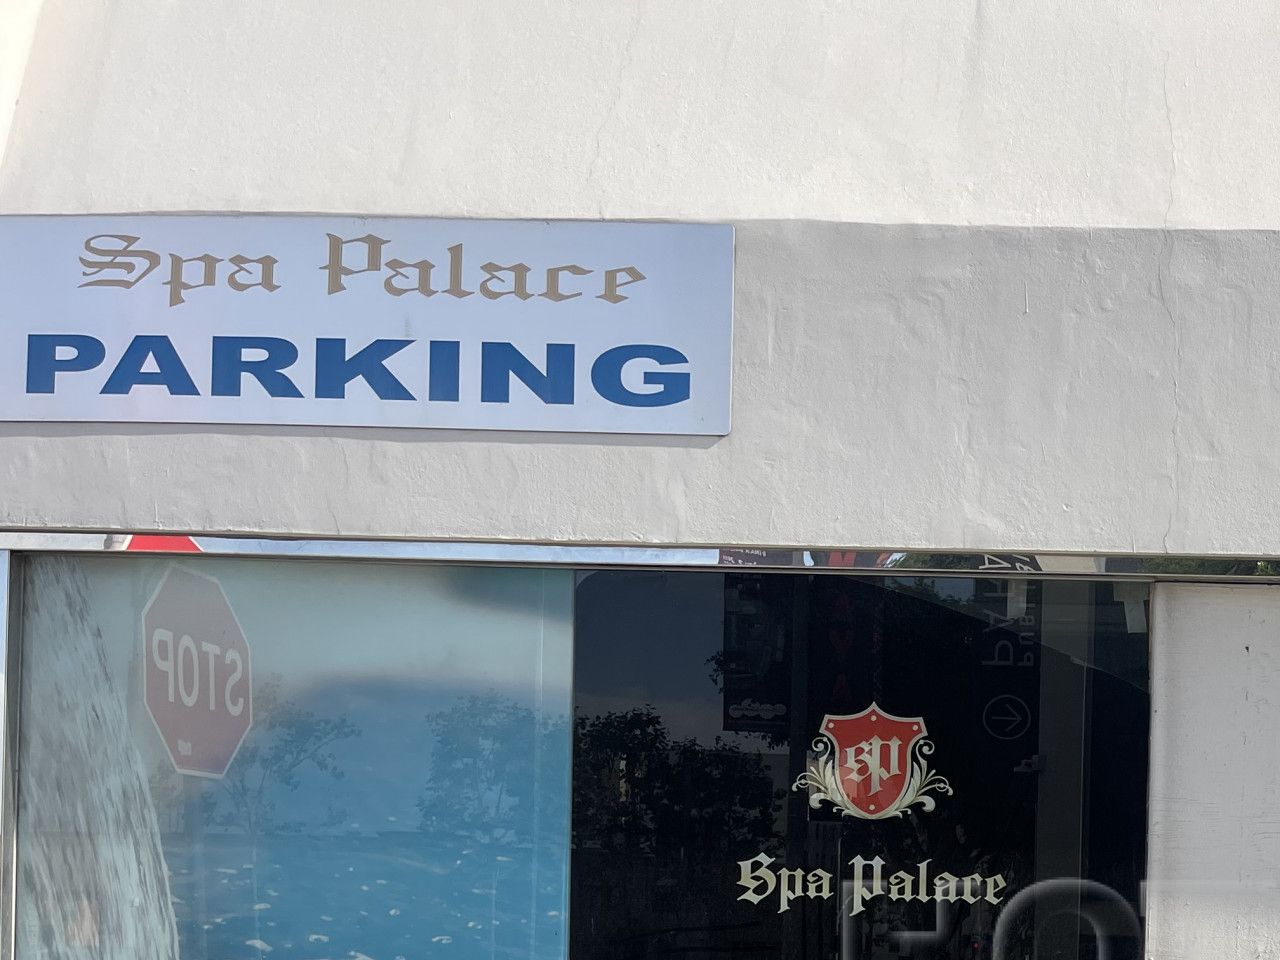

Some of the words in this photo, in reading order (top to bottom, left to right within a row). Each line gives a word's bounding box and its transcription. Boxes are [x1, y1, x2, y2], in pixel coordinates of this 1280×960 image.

[77, 232, 280, 308] Spa
[319, 232, 647, 305] Palace
[24, 333, 693, 408] PARKING
[736, 852, 834, 915] Spa
[847, 854, 1007, 918] Palace
